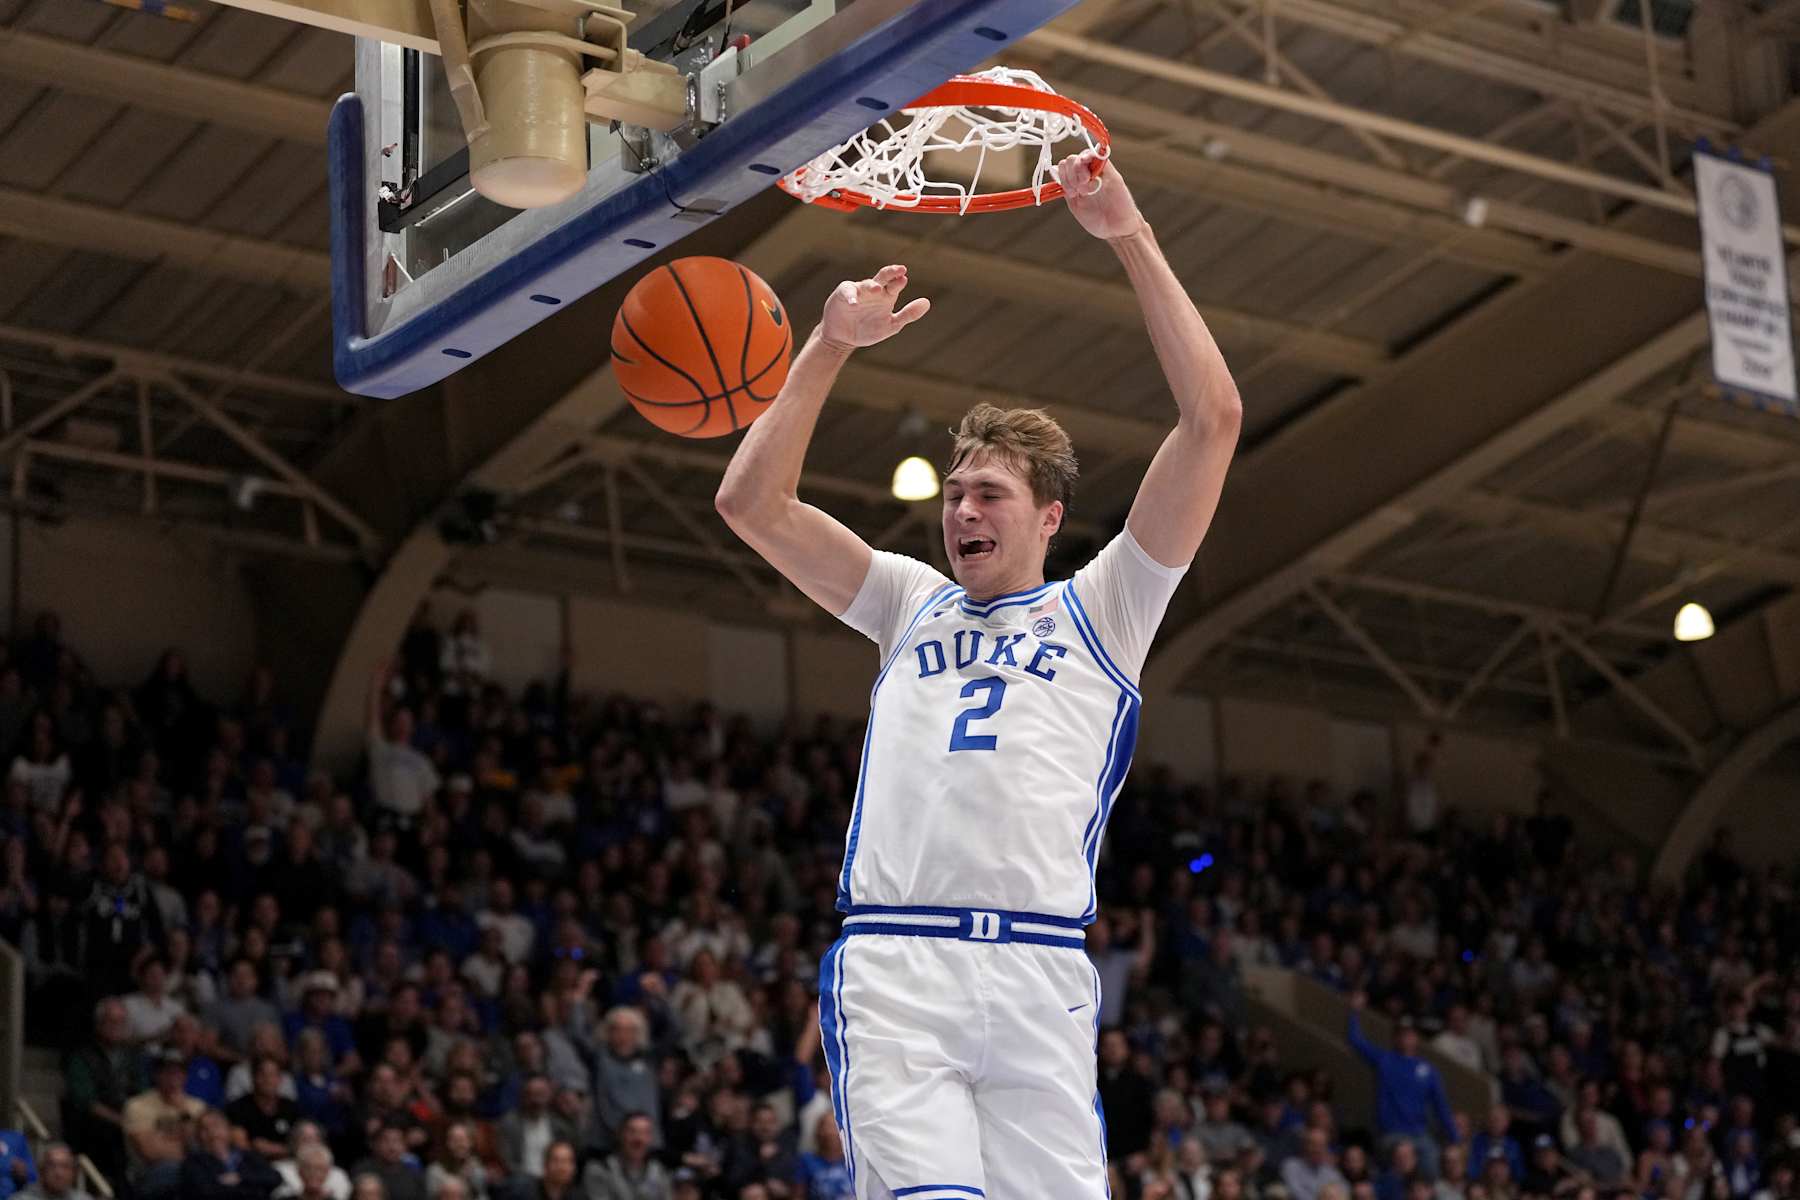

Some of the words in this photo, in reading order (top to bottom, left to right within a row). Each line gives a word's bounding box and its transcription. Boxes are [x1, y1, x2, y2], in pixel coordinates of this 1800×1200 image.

[915, 630, 1068, 682] DUKE
[949, 675, 1007, 752] 2
[969, 911, 1000, 940] D
